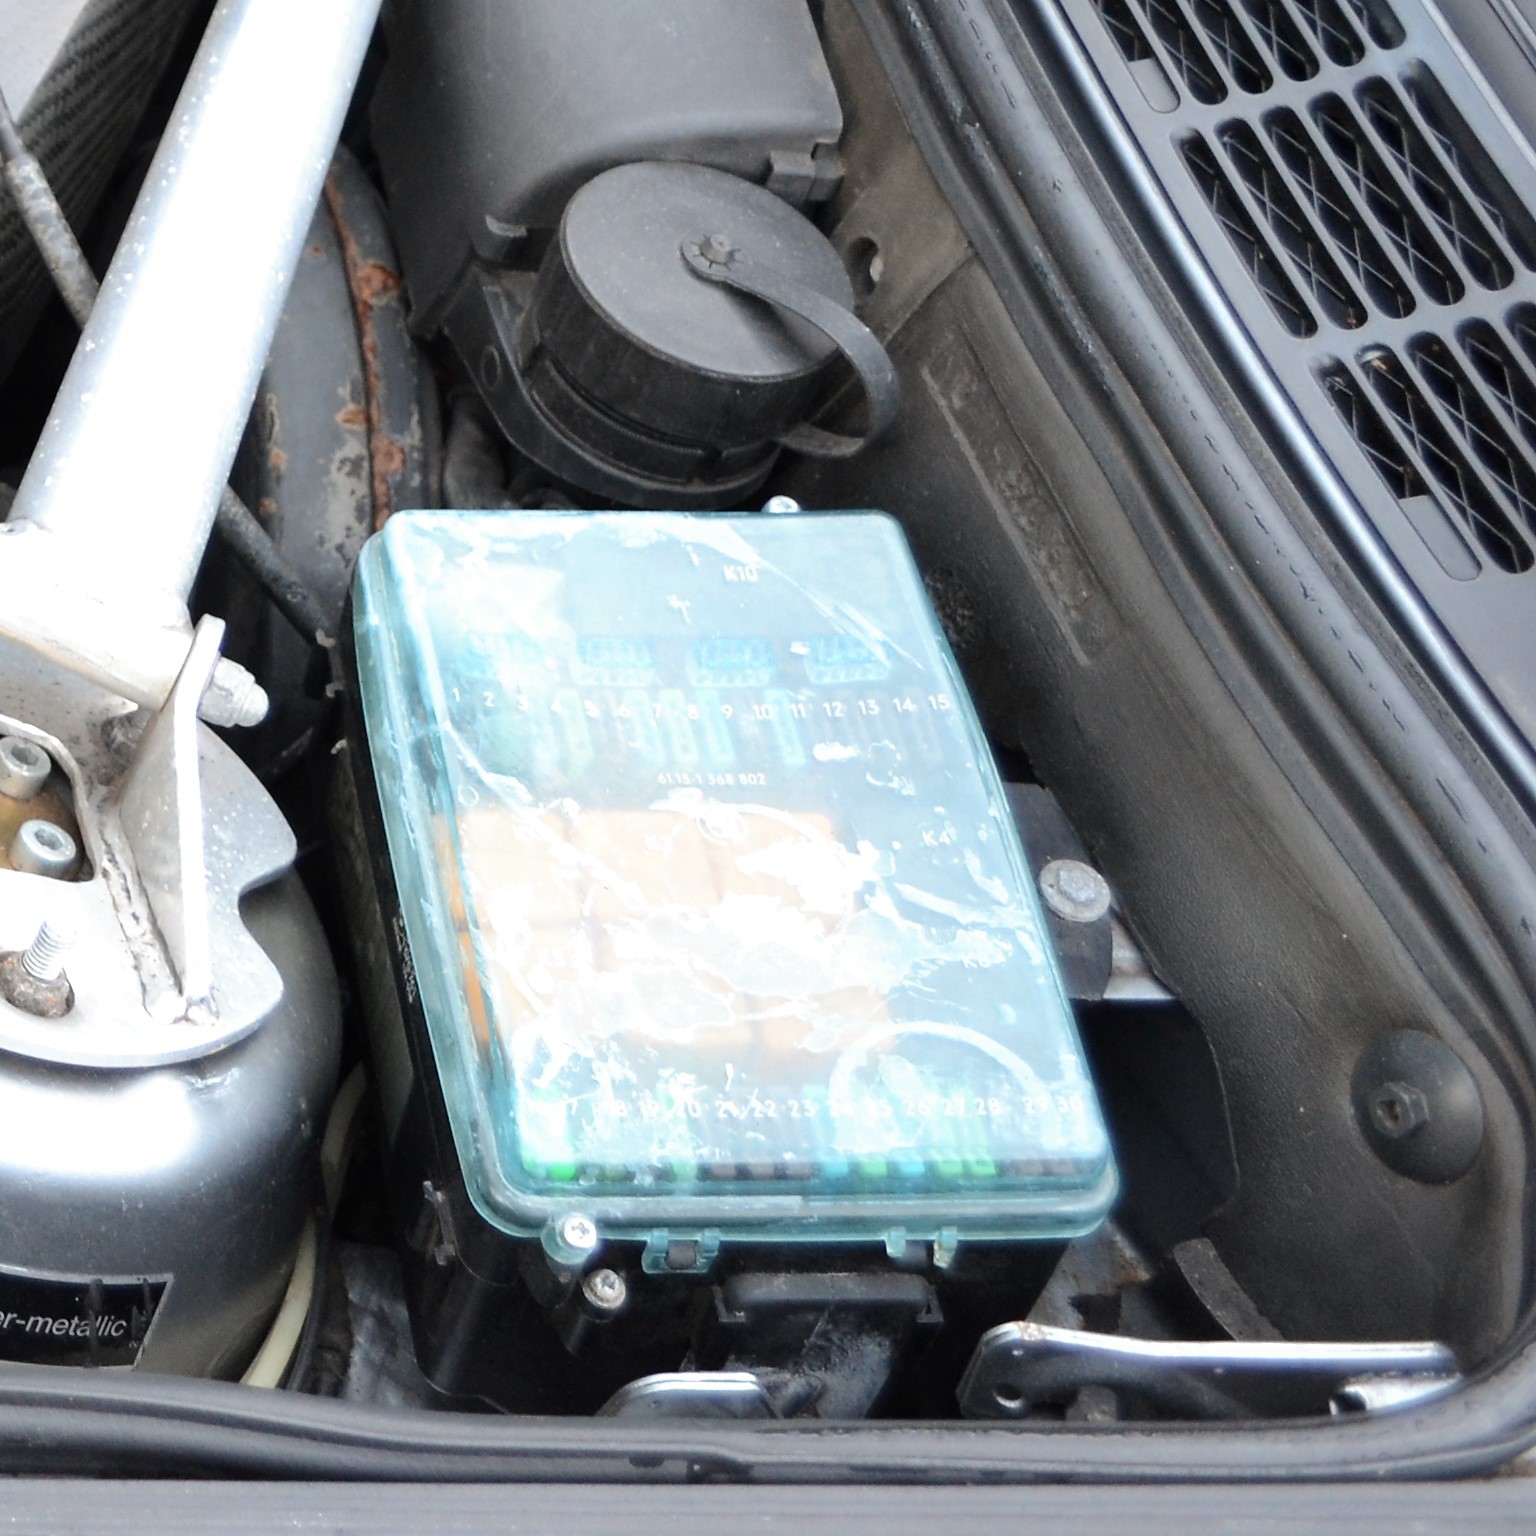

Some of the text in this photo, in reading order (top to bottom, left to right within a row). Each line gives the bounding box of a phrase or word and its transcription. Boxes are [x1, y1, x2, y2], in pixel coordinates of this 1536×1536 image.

[723, 566, 760, 583] K10
[482, 691, 495, 708] 2
[720, 703, 734, 720] 9
[751, 703, 773, 720] 10
[790, 703, 807, 719] 11
[823, 701, 844, 718] 12
[857, 700, 880, 716] 13
[892, 697, 915, 713] 14
[927, 695, 950, 712] 15
[921, 828, 951, 847] K4
[788, 1099, 817, 1118] 23
[902, 1098, 931, 1117] 26
[973, 1096, 1002, 1116] 28
[1054, 1094, 1084, 1114] 30
